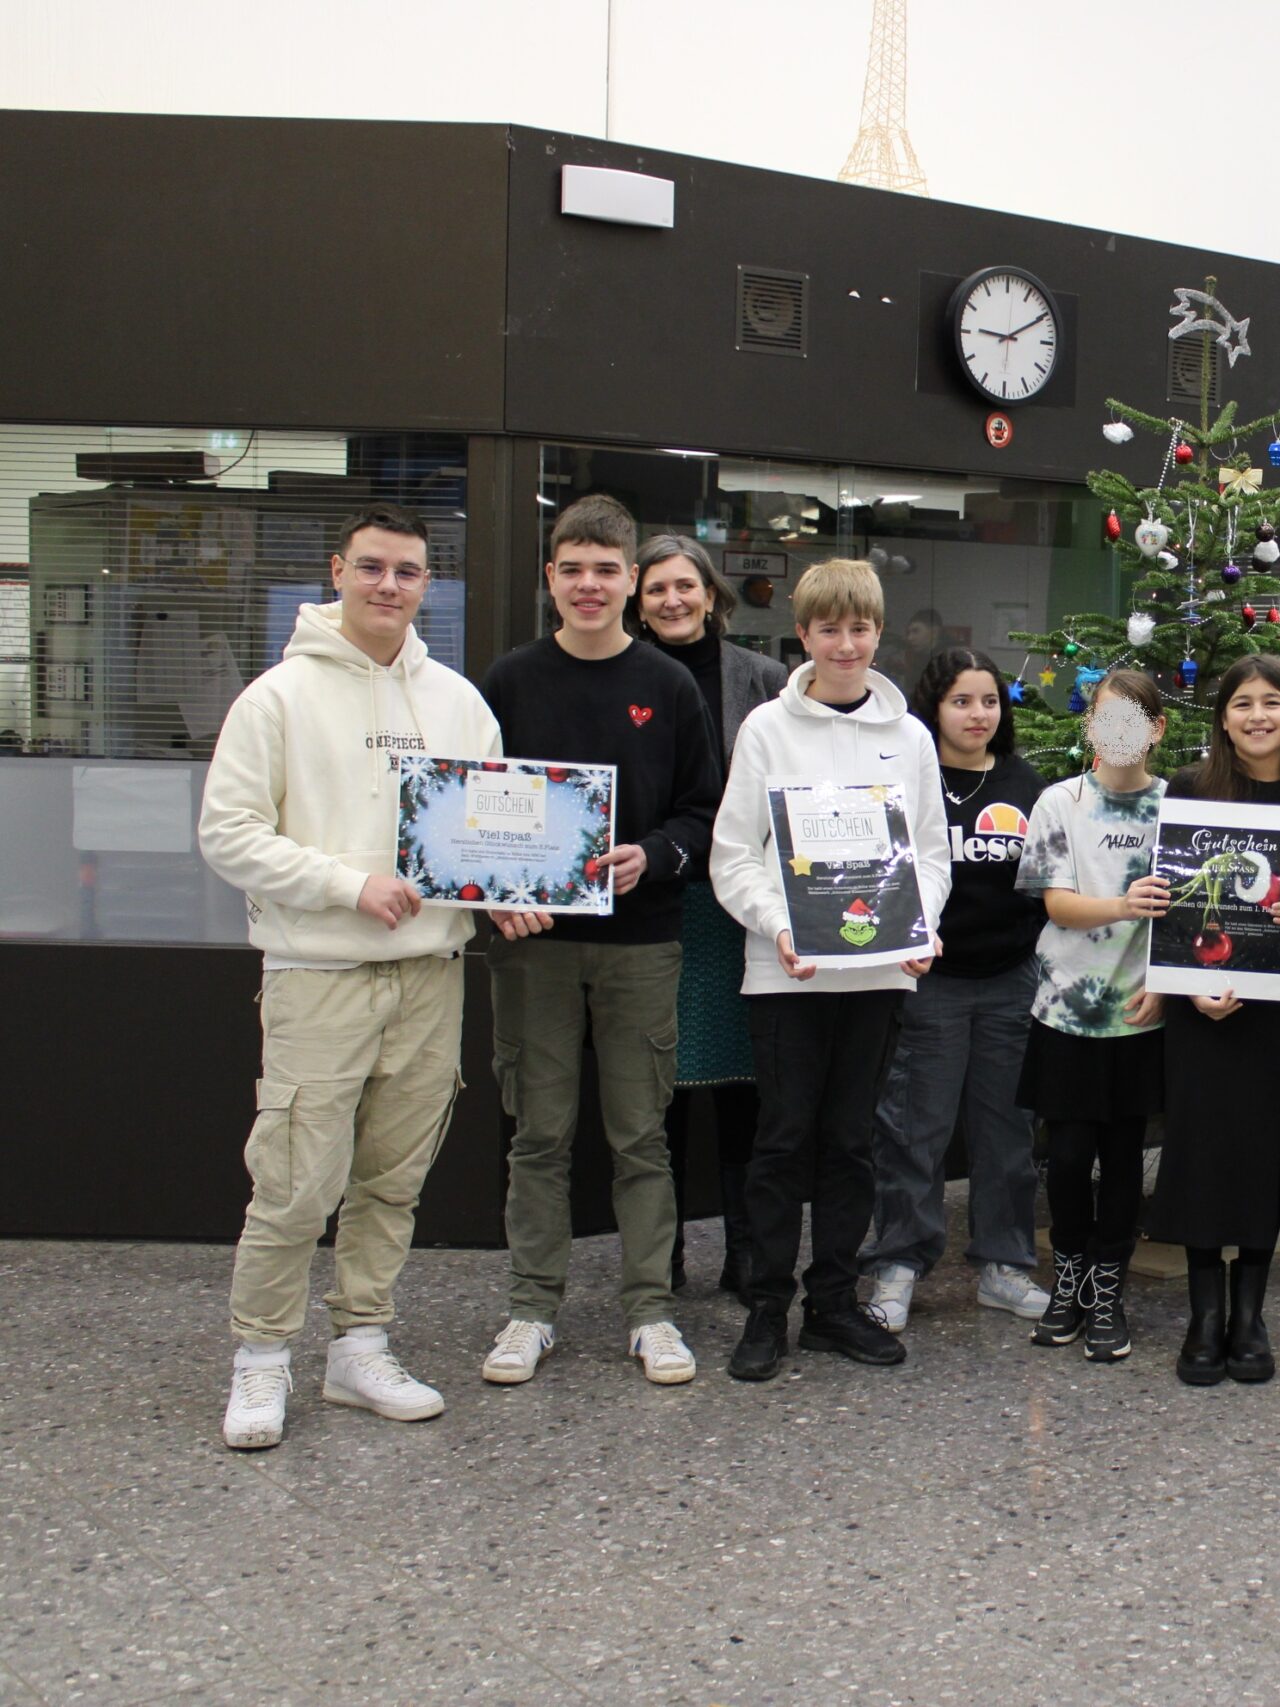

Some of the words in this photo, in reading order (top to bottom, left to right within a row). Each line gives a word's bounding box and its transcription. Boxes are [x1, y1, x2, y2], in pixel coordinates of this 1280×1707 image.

[743, 558, 769, 570] BMZ
[476, 794, 535, 814] GUTSCHEIN
[478, 829, 500, 840] Viel
[503, 831, 532, 843] Spaß
[802, 817, 874, 838] GUTSCHEIN
[949, 825, 1025, 862] less
[1098, 833, 1146, 849] MALIBU
[1191, 828, 1278, 854] Gutschein
